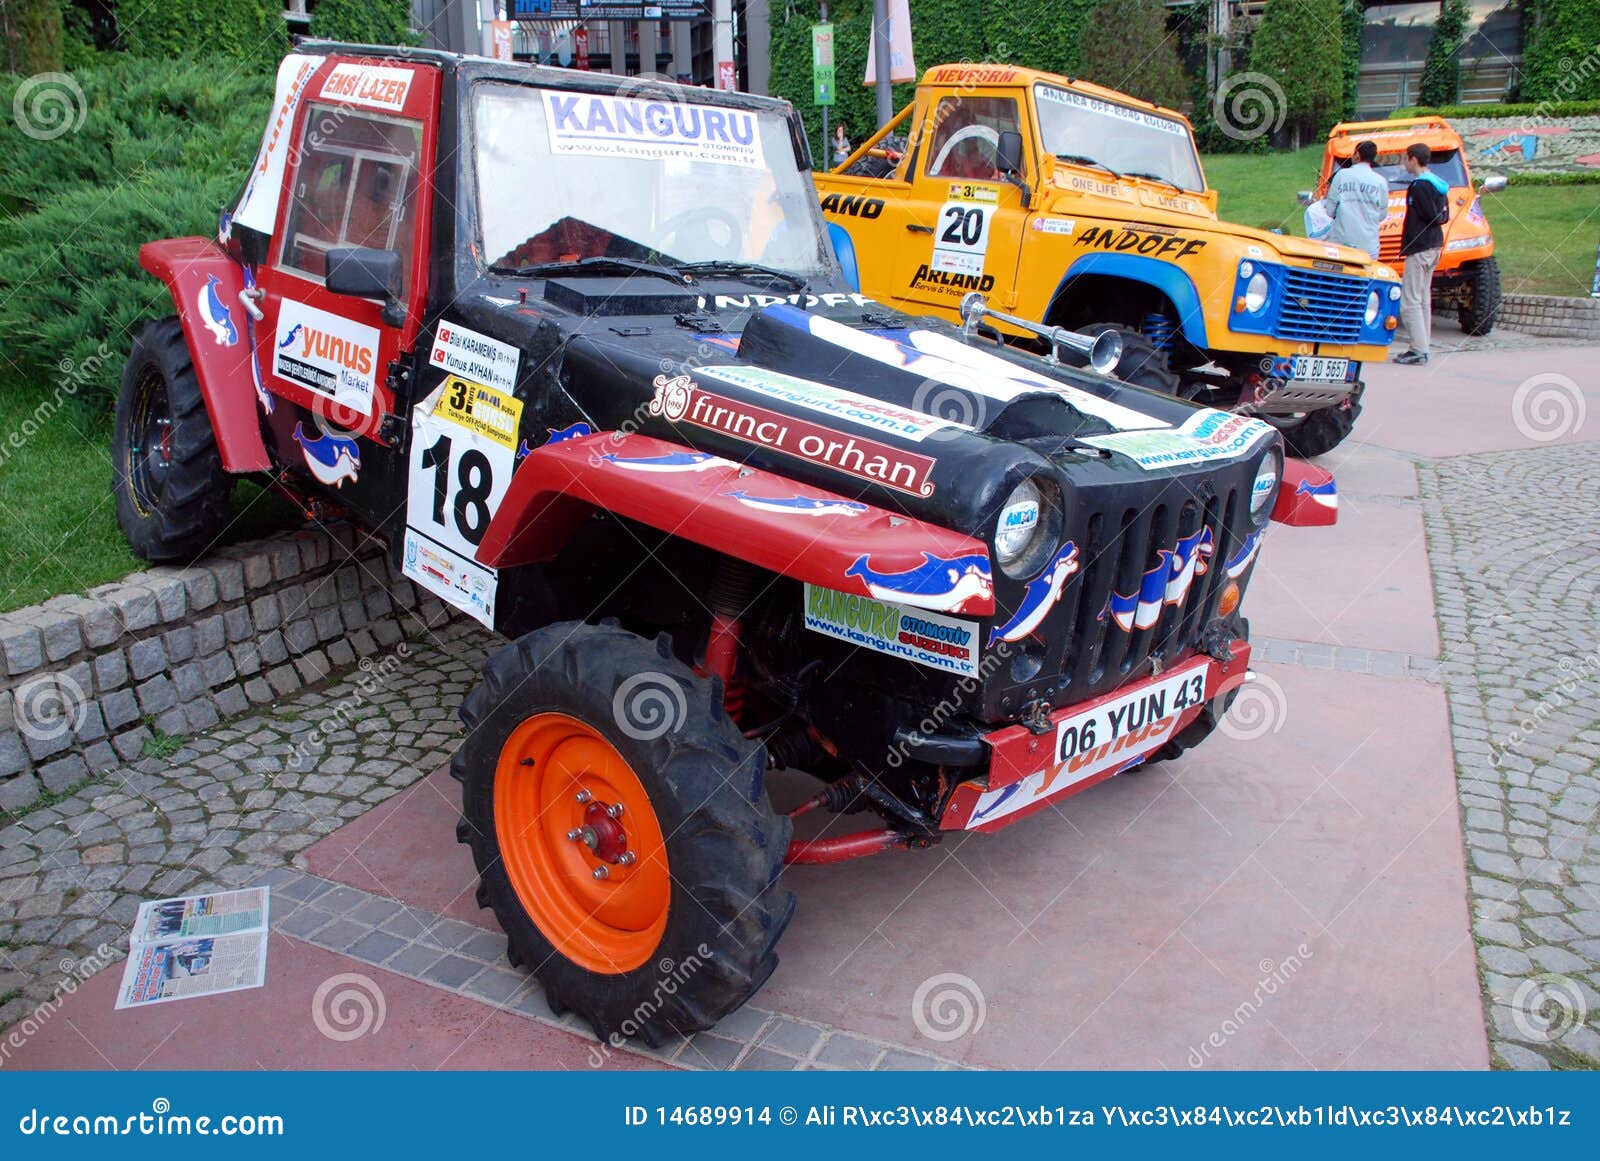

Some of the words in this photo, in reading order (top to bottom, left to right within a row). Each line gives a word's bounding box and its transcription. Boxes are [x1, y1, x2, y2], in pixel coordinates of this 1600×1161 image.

[359, 75, 407, 105] LAZER
[1042, 87, 1087, 108] ANKARA
[1090, 98, 1140, 122] OFF-ROAD
[259, 62, 311, 176] yunus
[549, 95, 754, 146] KANGURU
[556, 144, 756, 165] www.kanguru.com.tr
[1072, 177, 1094, 191] ONE
[1095, 180, 1118, 197] LIFE
[1158, 195, 1179, 210] LIVE
[941, 206, 984, 246] 20
[1073, 226, 1207, 260] ANDOFF
[909, 264, 995, 292] ARLAND
[301, 325, 373, 376] yunus
[341, 369, 369, 393] Market
[446, 352, 467, 371] Yunus
[468, 361, 494, 384] AYHAN
[1296, 359, 1308, 377] 06
[1325, 360, 1347, 378] 5657
[799, 434, 918, 489] orhan
[421, 434, 493, 546] 18
[807, 585, 900, 641] KANGURU
[806, 616, 975, 673] www.kanguru.com.tr
[898, 631, 970, 661] SUZUKI
[900, 615, 971, 646] OTOMOTİV
[1059, 718, 1098, 762] 06
[1107, 689, 1167, 739] YUN
[1173, 674, 1205, 711] 43
